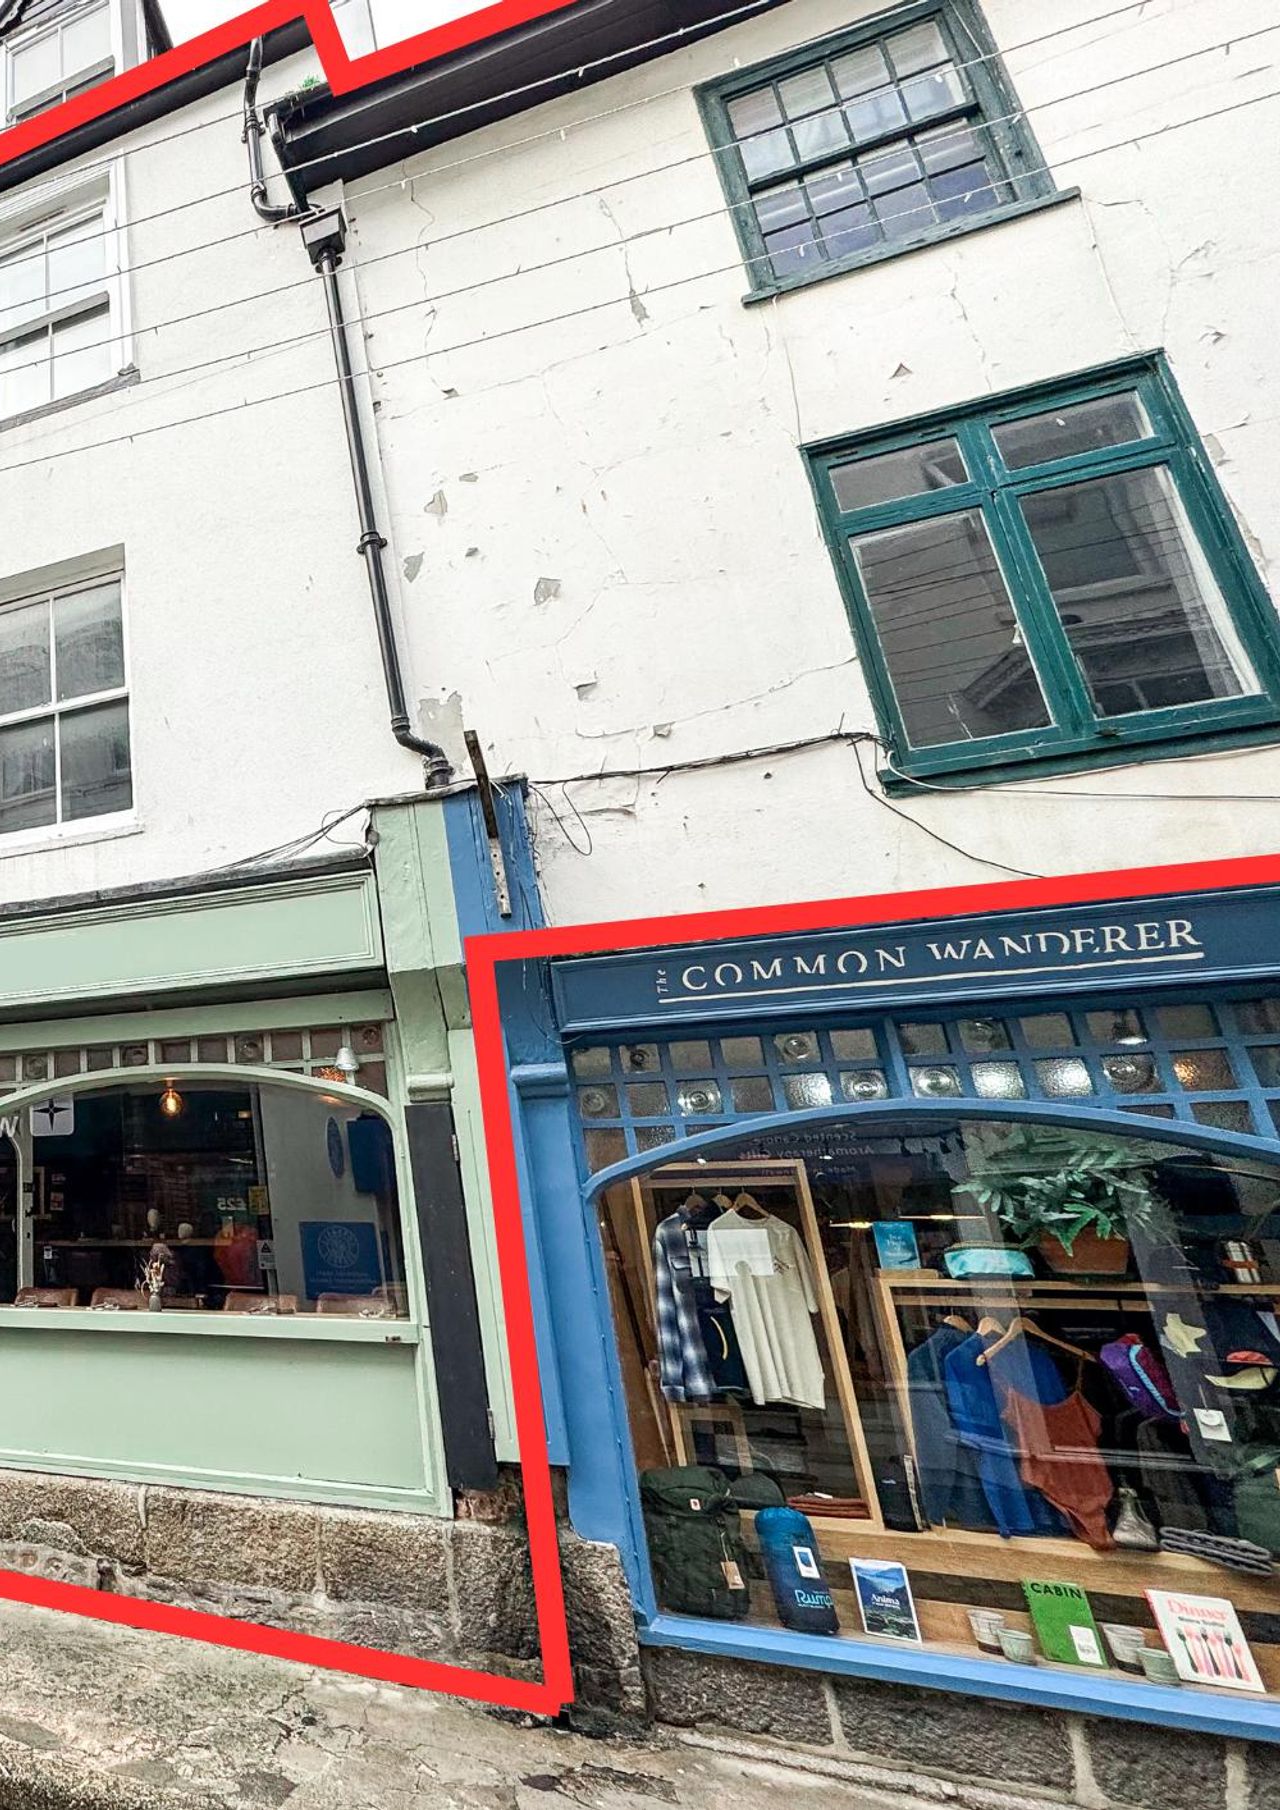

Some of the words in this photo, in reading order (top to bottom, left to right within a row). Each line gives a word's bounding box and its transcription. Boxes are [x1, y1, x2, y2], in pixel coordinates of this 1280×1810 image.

[655, 968, 668, 994] The
[681, 946, 906, 991] COMMON
[926, 920, 1203, 961] WANDERER
[1030, 1582, 1083, 1599] CABIN
